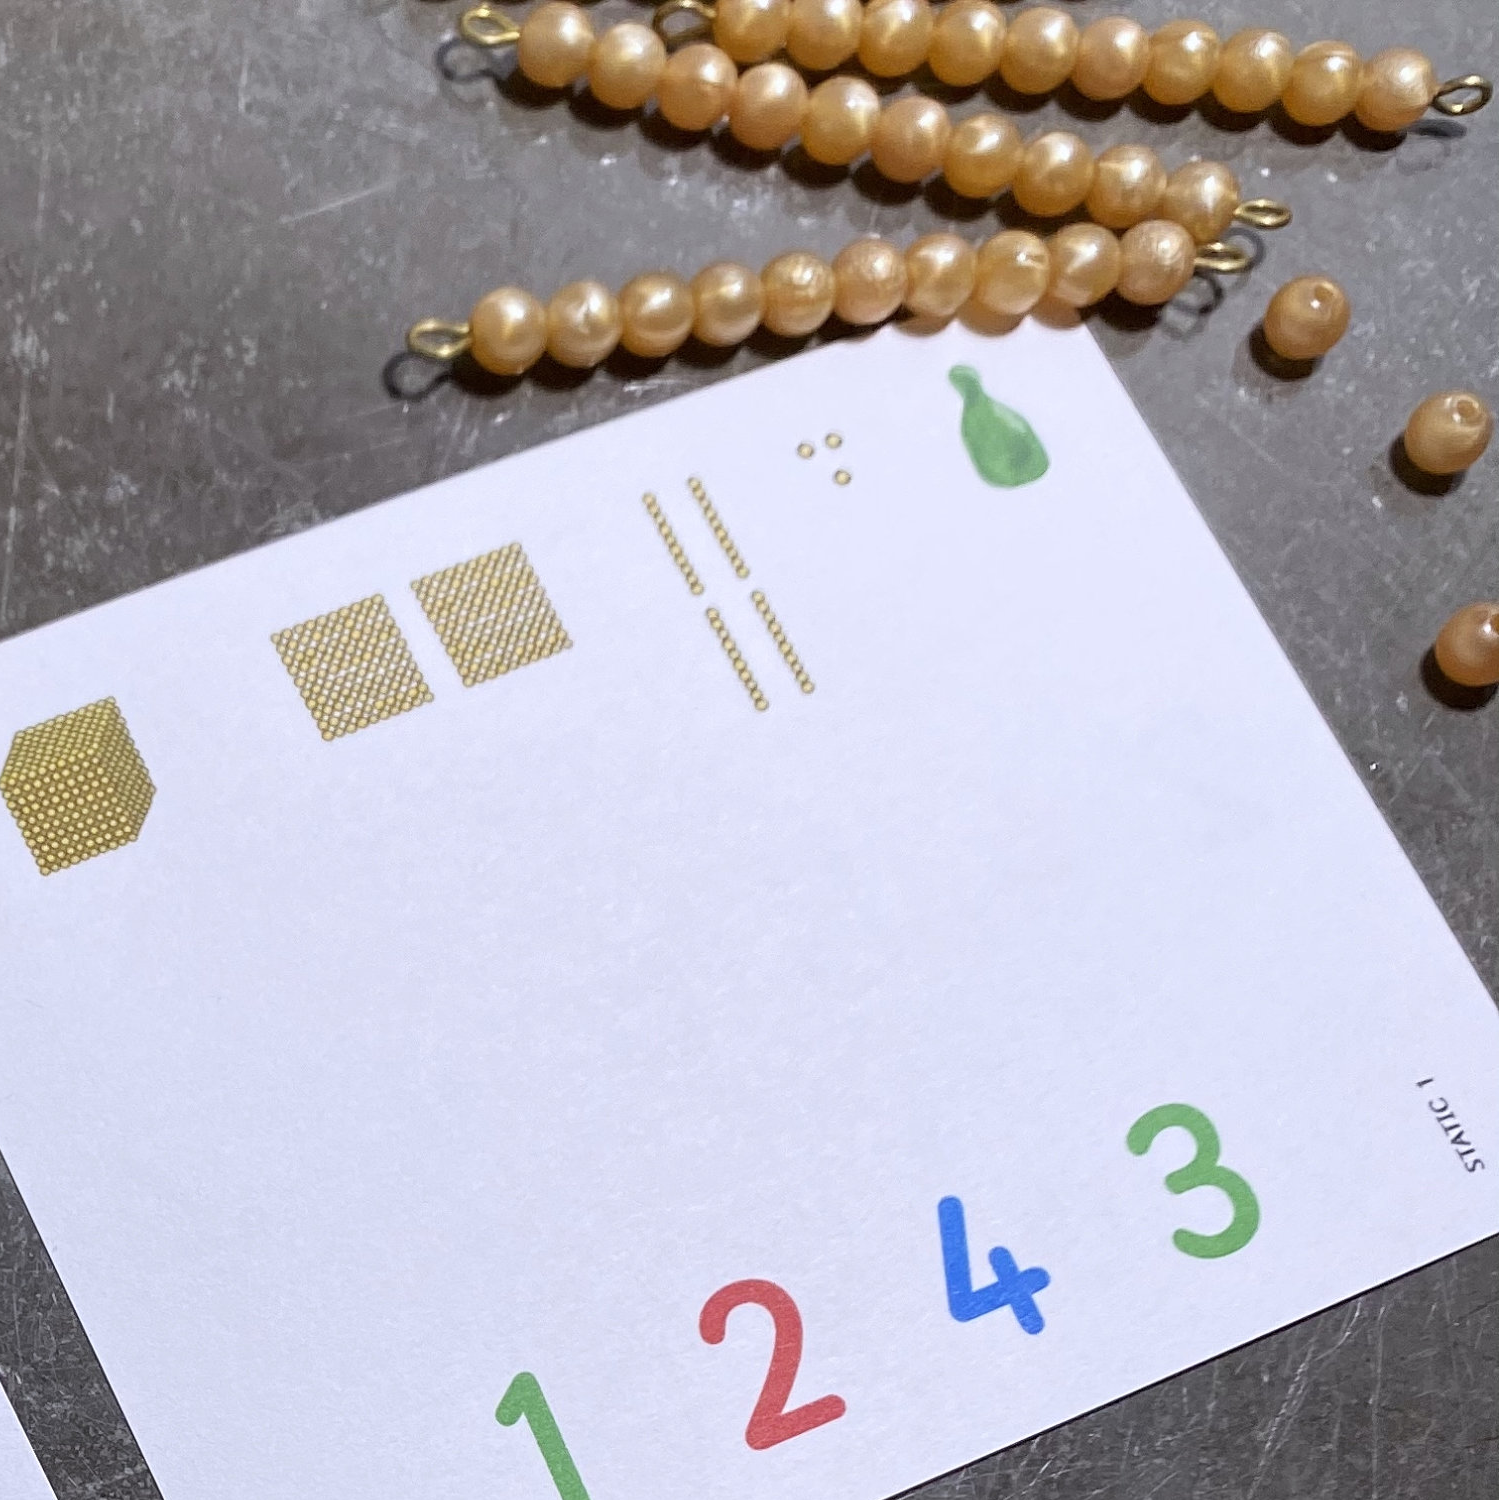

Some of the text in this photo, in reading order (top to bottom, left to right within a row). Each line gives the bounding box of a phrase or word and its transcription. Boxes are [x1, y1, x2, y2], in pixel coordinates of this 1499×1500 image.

[1414, 1076, 1486, 1173] STATIC 1
[699, 1280, 845, 1450] 2
[937, 1196, 1051, 1335] 4
[1126, 1103, 1261, 1260] 3
